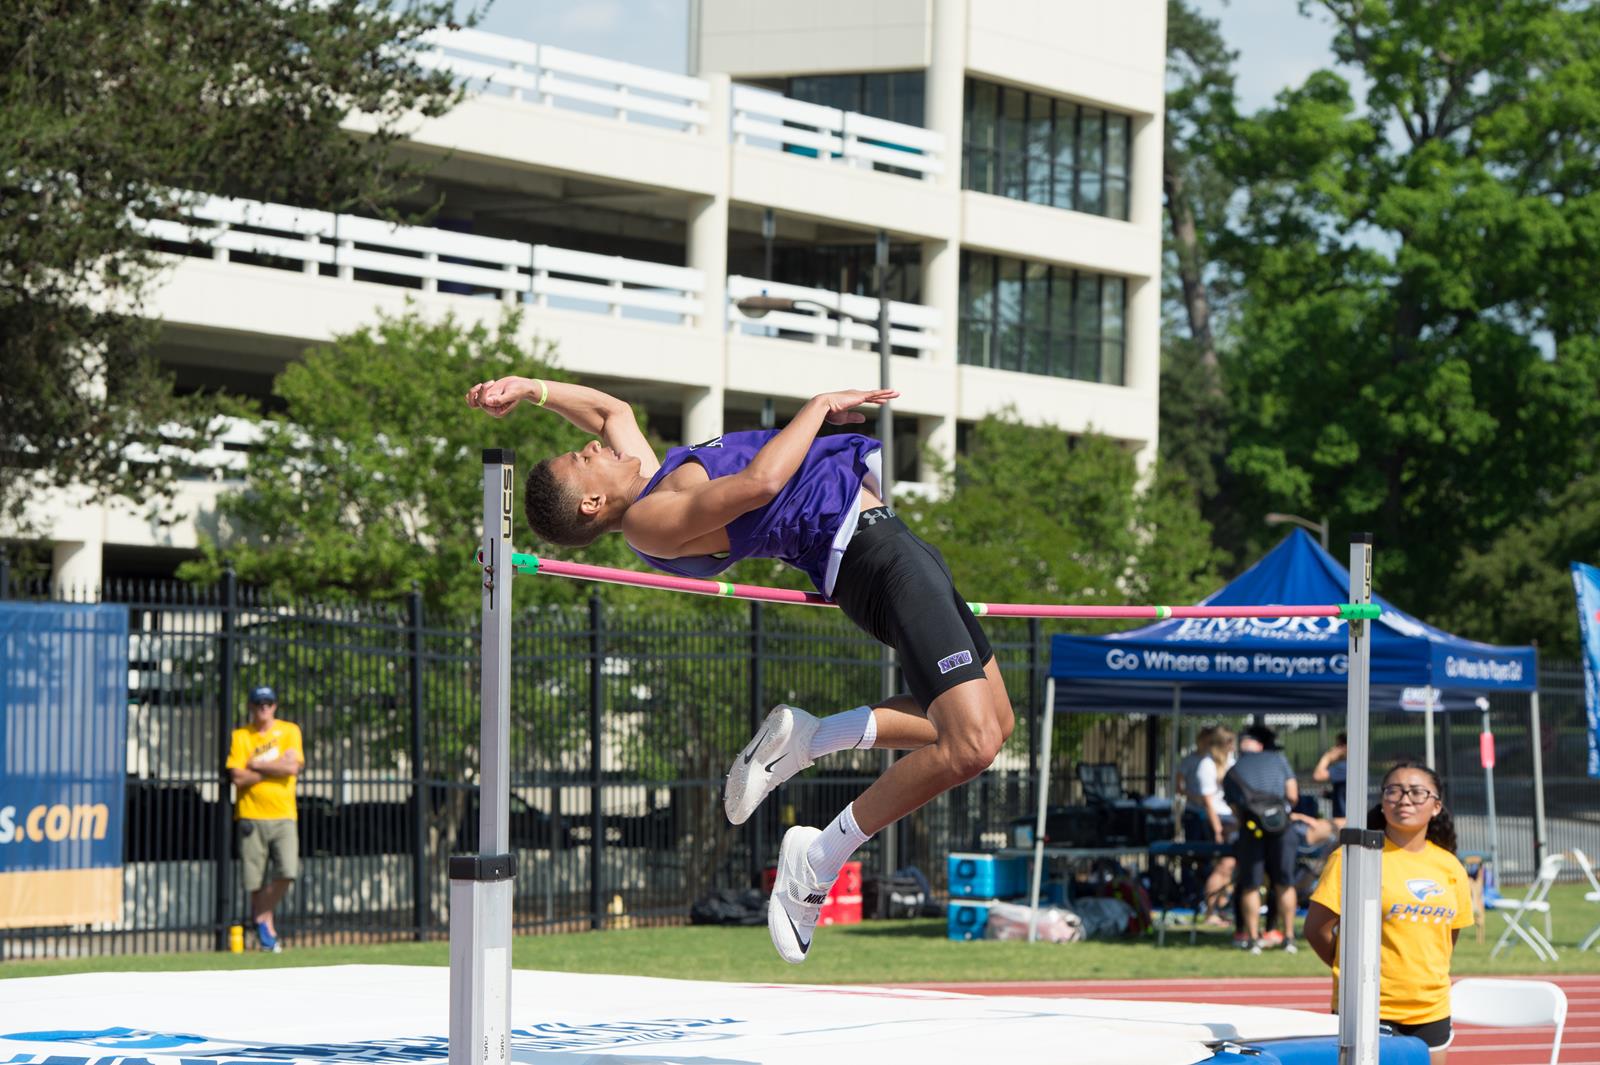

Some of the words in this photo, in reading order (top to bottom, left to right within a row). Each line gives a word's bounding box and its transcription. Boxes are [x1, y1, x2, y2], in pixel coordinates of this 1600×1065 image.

[503, 468, 512, 539] UCS
[1105, 648, 1139, 671] Go
[1143, 651, 1210, 673] Where
[1215, 653, 1249, 674] the
[1253, 653, 1326, 678] Players
[1328, 654, 1349, 674] G
[803, 893, 828, 905] NIKE
[1390, 903, 1456, 919] EMORY
